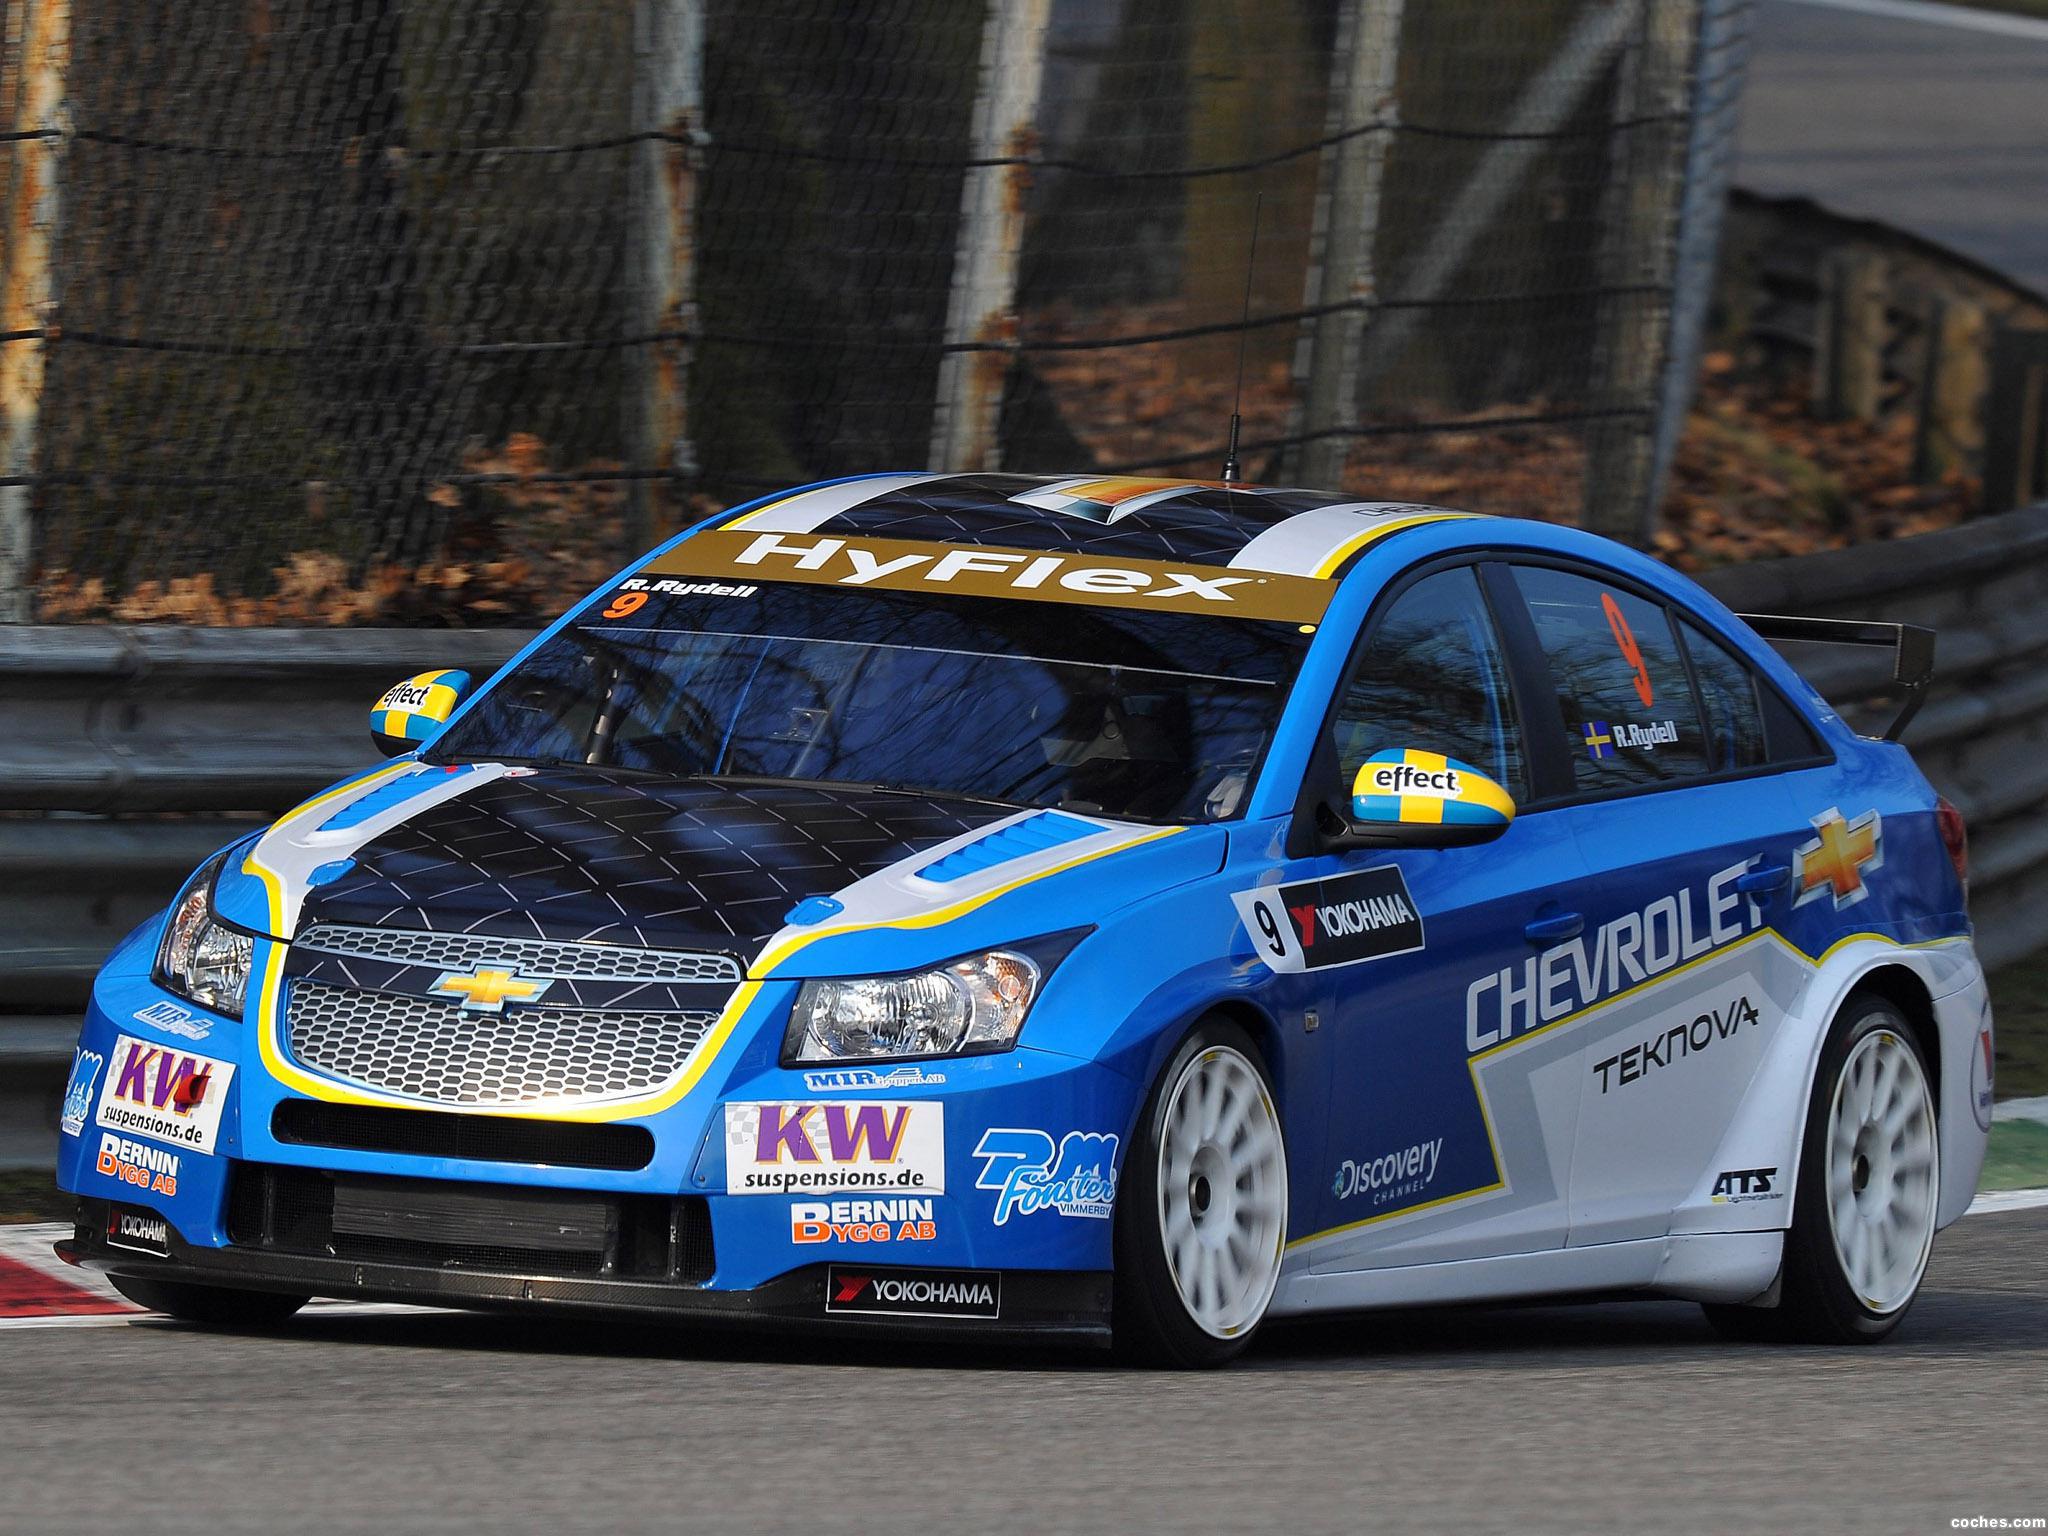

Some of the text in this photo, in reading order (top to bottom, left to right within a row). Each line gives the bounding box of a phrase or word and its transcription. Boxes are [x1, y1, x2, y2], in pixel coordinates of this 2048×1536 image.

[734, 534, 1256, 601] HyFlex
[619, 578, 758, 598] R.Rydell
[602, 591, 649, 619] 9
[1601, 592, 1653, 707] 9
[384, 683, 430, 707] effect
[1613, 720, 1679, 750] R.Rydell
[1376, 766, 1456, 792] effect
[1253, 900, 1286, 957] 9
[1315, 893, 1415, 938] YOKOHAMA
[114, 1043, 213, 1117] KW
[808, 1072, 873, 1087] MIR
[103, 1105, 203, 1144] suspensions.de
[755, 1104, 912, 1165] KW
[745, 1167, 924, 1193] suspensions.de
[1340, 1138, 1443, 1199] Discovery
[1711, 1167, 1778, 1195] ATS
[151, 1173, 177, 1196] AB
[1374, 1180, 1424, 1205] CHANNEL
[1060, 1202, 1111, 1215] VIMMERBY
[120, 1213, 167, 1242] YOKOHAMA
[896, 1220, 936, 1241] AB
[873, 1280, 993, 1304] YOKOHAMA
